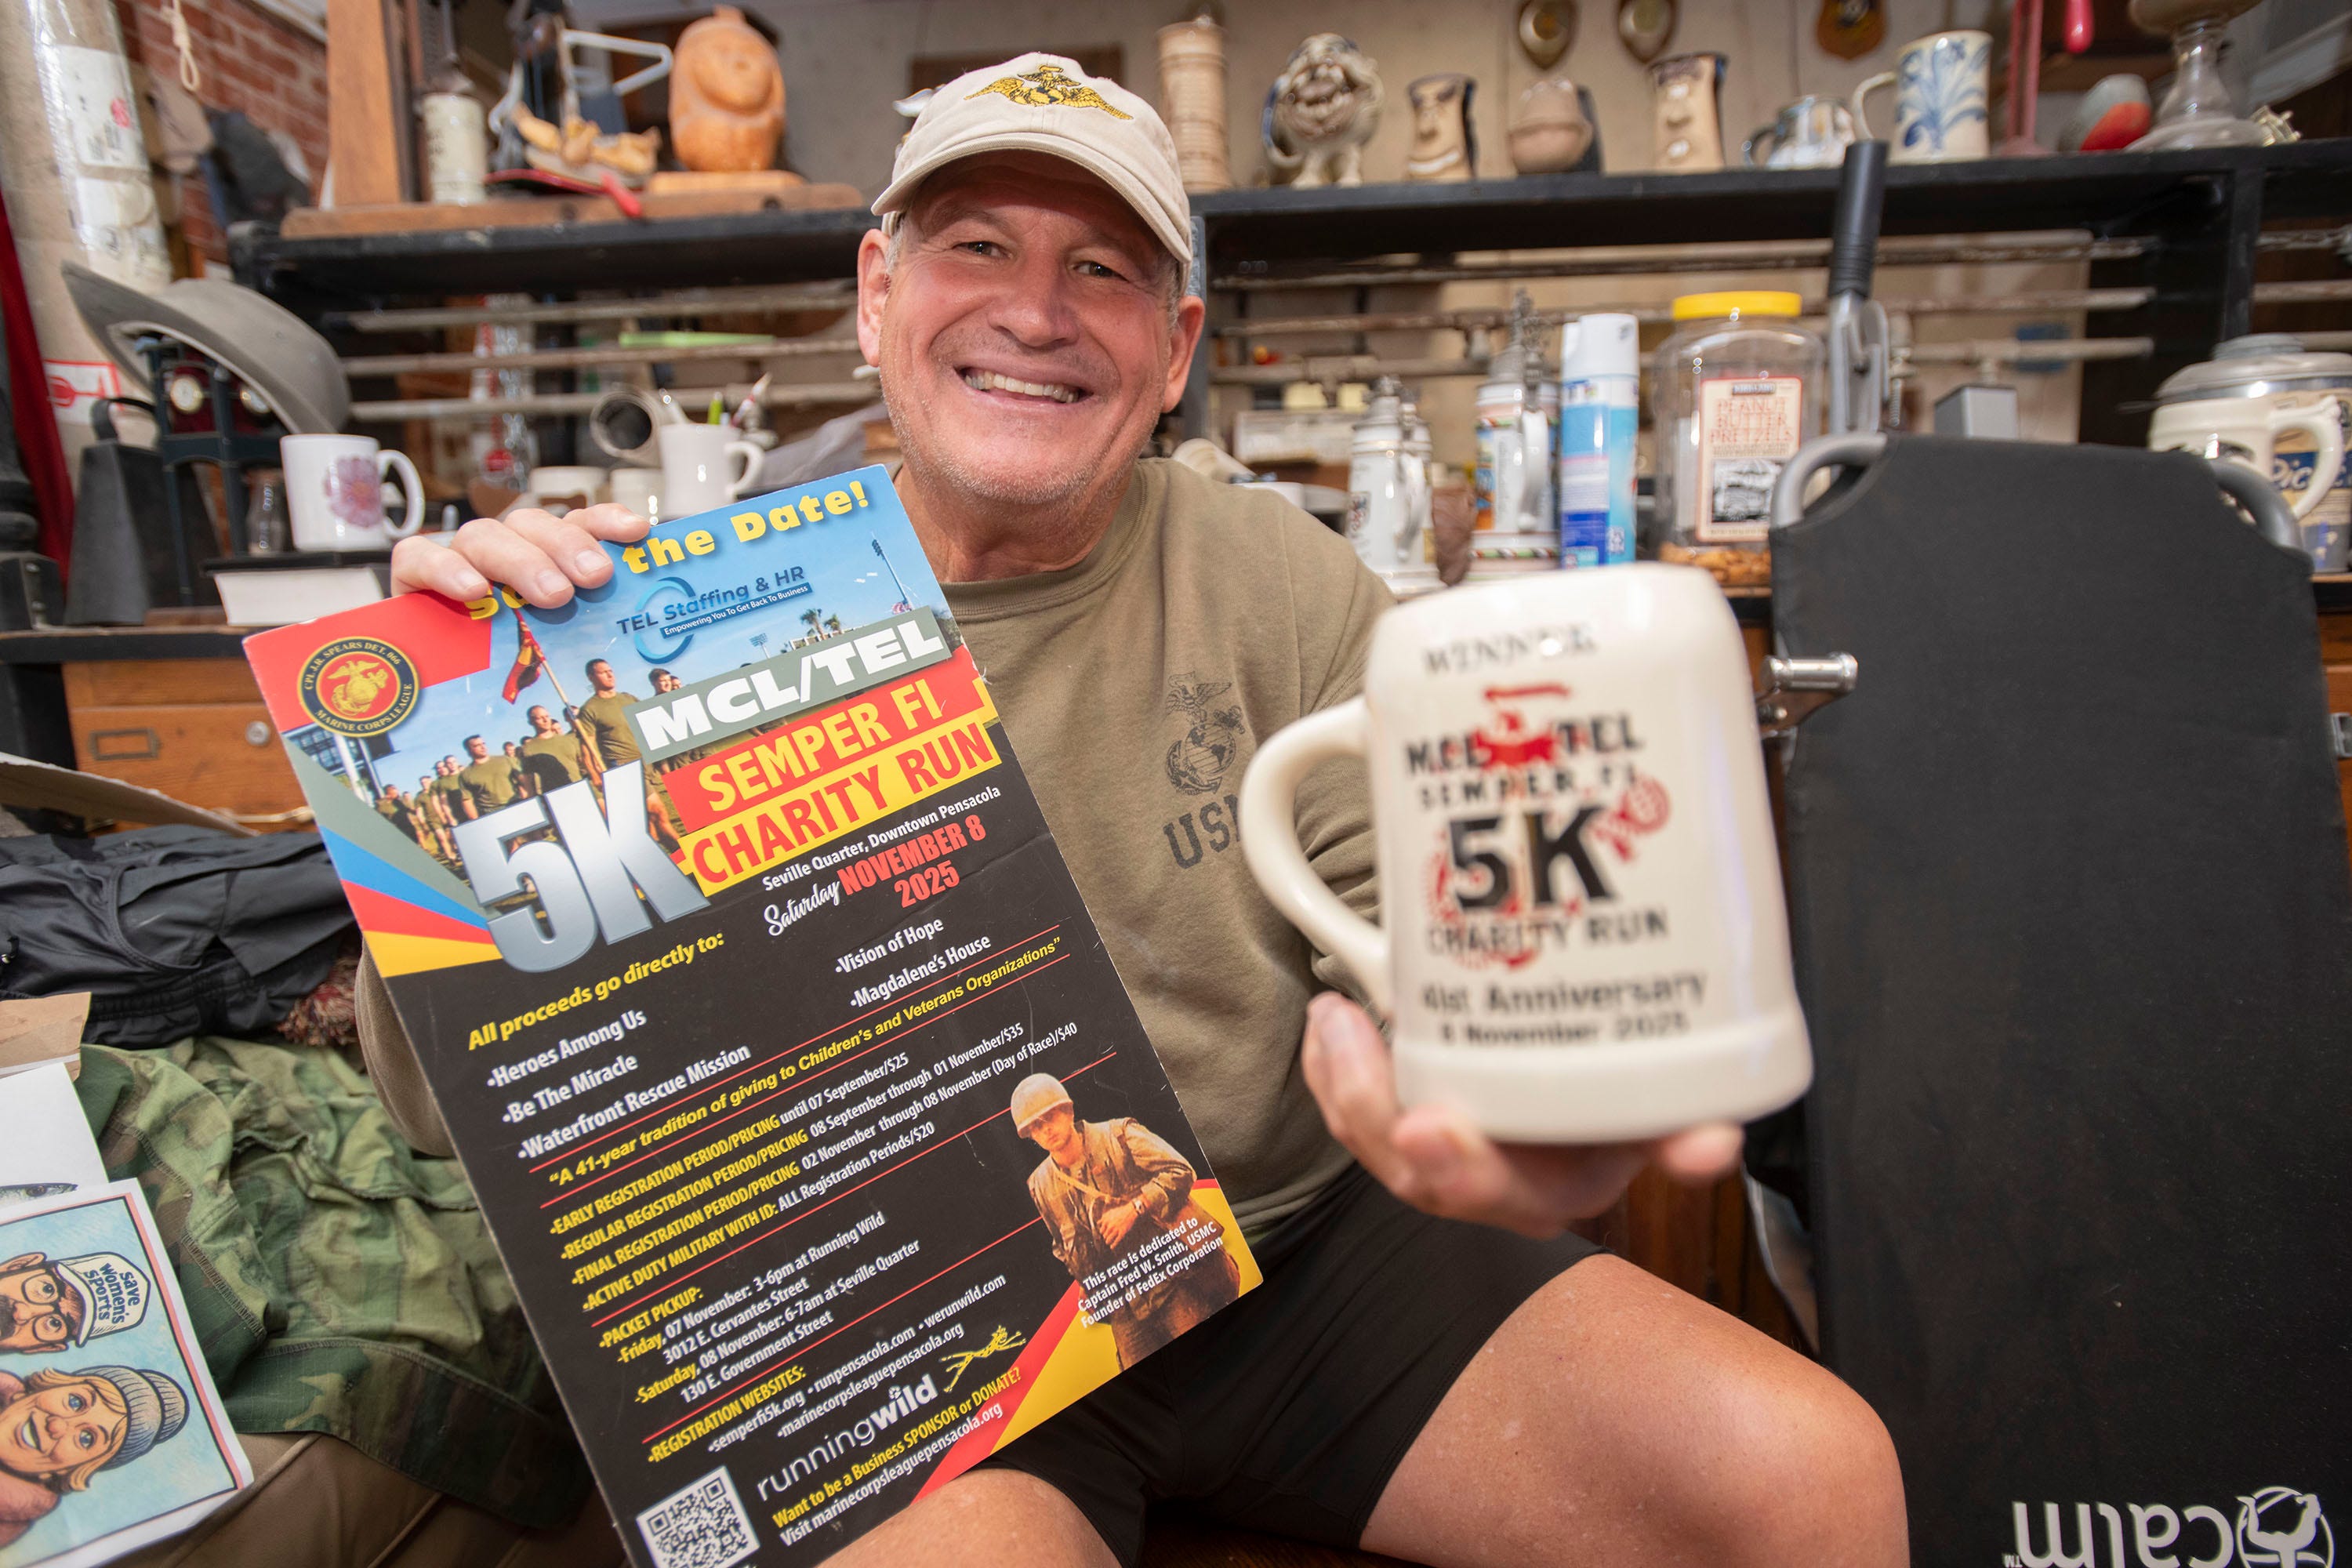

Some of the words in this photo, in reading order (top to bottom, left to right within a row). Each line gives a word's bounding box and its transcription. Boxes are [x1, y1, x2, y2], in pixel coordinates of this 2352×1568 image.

[622, 531, 714, 573] the
[731, 481, 867, 541] Date!
[616, 612, 659, 634] TEL
[662, 585, 750, 620] Staffing
[756, 577, 770, 592] &
[775, 565, 805, 586] HR
[663, 615, 712, 636] Empowering
[711, 612, 727, 622] You
[735, 603, 750, 612] Get
[750, 597, 768, 608] Back
[768, 594, 779, 604] To
[778, 586, 808, 600] Business
[323, 642, 362, 659] SPEARS
[364, 642, 385, 655] DET.
[387, 652, 401, 665] 066
[635, 619, 944, 751] MCL/TEL
[315, 710, 357, 731] MARINE
[357, 718, 391, 731] CORPS
[391, 684, 412, 718] LEAGUE
[699, 699, 891, 811] SEMPER
[895, 679, 944, 730] FI
[693, 769, 894, 884] CHARITY
[897, 729, 994, 794] RUN
[762, 863, 812, 891] Seville
[811, 841, 869, 870] Quarter,
[867, 811, 939, 848] Downtown
[938, 786, 1001, 819] Pensacola
[453, 758, 711, 973] 5K
[764, 880, 840, 936] Saturday
[837, 822, 968, 896] NOVEMBER
[964, 814, 986, 841] 8
[894, 859, 960, 909] 2025
[1448, 803, 1618, 911] 5K
[887, 931, 905, 953] of
[902, 919, 945, 945] Hope
[944, 936, 992, 965] House
[1427, 921, 1568, 956] CHARITY
[1586, 906, 1668, 942] RUN
[468, 1022, 498, 1051] All
[499, 986, 593, 1042] proceeds
[594, 976, 622, 1001] go
[623, 944, 695, 984] directly
[696, 933, 724, 953] to:
[1486, 971, 1709, 1013] Anniversary
[559, 1021, 625, 1059] Among
[621, 1010, 647, 1030] Us
[1467, 1021, 1599, 1046] November
[532, 1085, 572, 1110] The
[570, 1055, 638, 1095] Miracle
[575, 1138, 637, 1175] 41-year
[639, 1106, 708, 1146] tradition
[710, 1093, 727, 1112] of
[729, 1073, 778, 1107] giving
[779, 1065, 797, 1080] to
[798, 1029, 873, 1071] Children’s
[875, 1011, 902, 1036] and
[902, 985, 964, 1021] Veterans
[623, 1075, 688, 1112] Rescue
[685, 1046, 751, 1084] Mission
[593, 1160, 685, 1214] REGISTRATION
[682, 1114, 781, 1171] PERIOD/PRICING
[779, 1099, 810, 1124] until
[808, 1092, 822, 1110] 07
[823, 1051, 909, 1103] September/$25
[614, 1209, 705, 1265] REGISTRATION
[702, 1161, 800, 1220] PERIOD/PRICING
[801, 1152, 819, 1170] 02
[817, 1125, 877, 1162] November
[877, 1100, 924, 1131] through
[923, 1092, 939, 1109] 08
[937, 1066, 992, 1102] November
[991, 1054, 1016, 1076] (Day
[1016, 1044, 1029, 1062] of
[1026, 1022, 1077, 1056] Race)/$40
[624, 1175, 714, 1229] REGISTRATION
[712, 1128, 809, 1186] PERIOD/PRICING
[809, 1120, 827, 1138] 08
[826, 1091, 887, 1130] September
[886, 1069, 933, 1099] through
[933, 1059, 949, 1076] 01
[947, 1022, 1024, 1069] November/$35
[631, 1256, 668, 1287] DUTY
[667, 1226, 726, 1268] MILITARY
[724, 1210, 760, 1237] WITH
[758, 1203, 779, 1221] ID:
[778, 1190, 802, 1212] ALL
[799, 1156, 871, 1200] Registration
[869, 1121, 935, 1164] Periods/$20
[1077, 1283, 1117, 1314] Captain
[1117, 1268, 1142, 1290] Fred
[1140, 1259, 1156, 1276] W.
[1154, 1240, 1188, 1267] Smith,
[1187, 1222, 1217, 1247] USMC
[1081, 1296, 1124, 1330] Founder
[1123, 1288, 1137, 1305] of
[1136, 1270, 1167, 1297] FedEx
[1166, 1235, 1224, 1279] Corporation
[1083, 1270, 1105, 1290] This
[1105, 1257, 1128, 1276] race
[1127, 1250, 1138, 1263] is
[1138, 1221, 1186, 1258] dedicated
[1186, 1215, 1198, 1228] to
[83, 1269, 112, 1320] sports
[100, 1263, 129, 1323] women’s
[118, 1272, 140, 1306] save
[651, 1287, 703, 1323] PICKUP:
[699, 1349, 719, 1369] 08
[716, 1315, 786, 1359] November:
[784, 1294, 825, 1322] 6-7am
[823, 1284, 839, 1301] at
[837, 1265, 877, 1294] Seville
[876, 1240, 920, 1271] Quarter
[739, 1365, 806, 1410] WEBSITES:
[772, 1498, 811, 1528] Want
[809, 1490, 826, 1506] to
[823, 1479, 843, 1497] be
[843, 1473, 853, 1486] a
[851, 1441, 906, 1481] Business
[903, 1405, 960, 1449] SPONSOR
[959, 1399, 972, 1414] or
[971, 1367, 1021, 1406] DONATE?
[2012, 1501, 2234, 1568] calm
